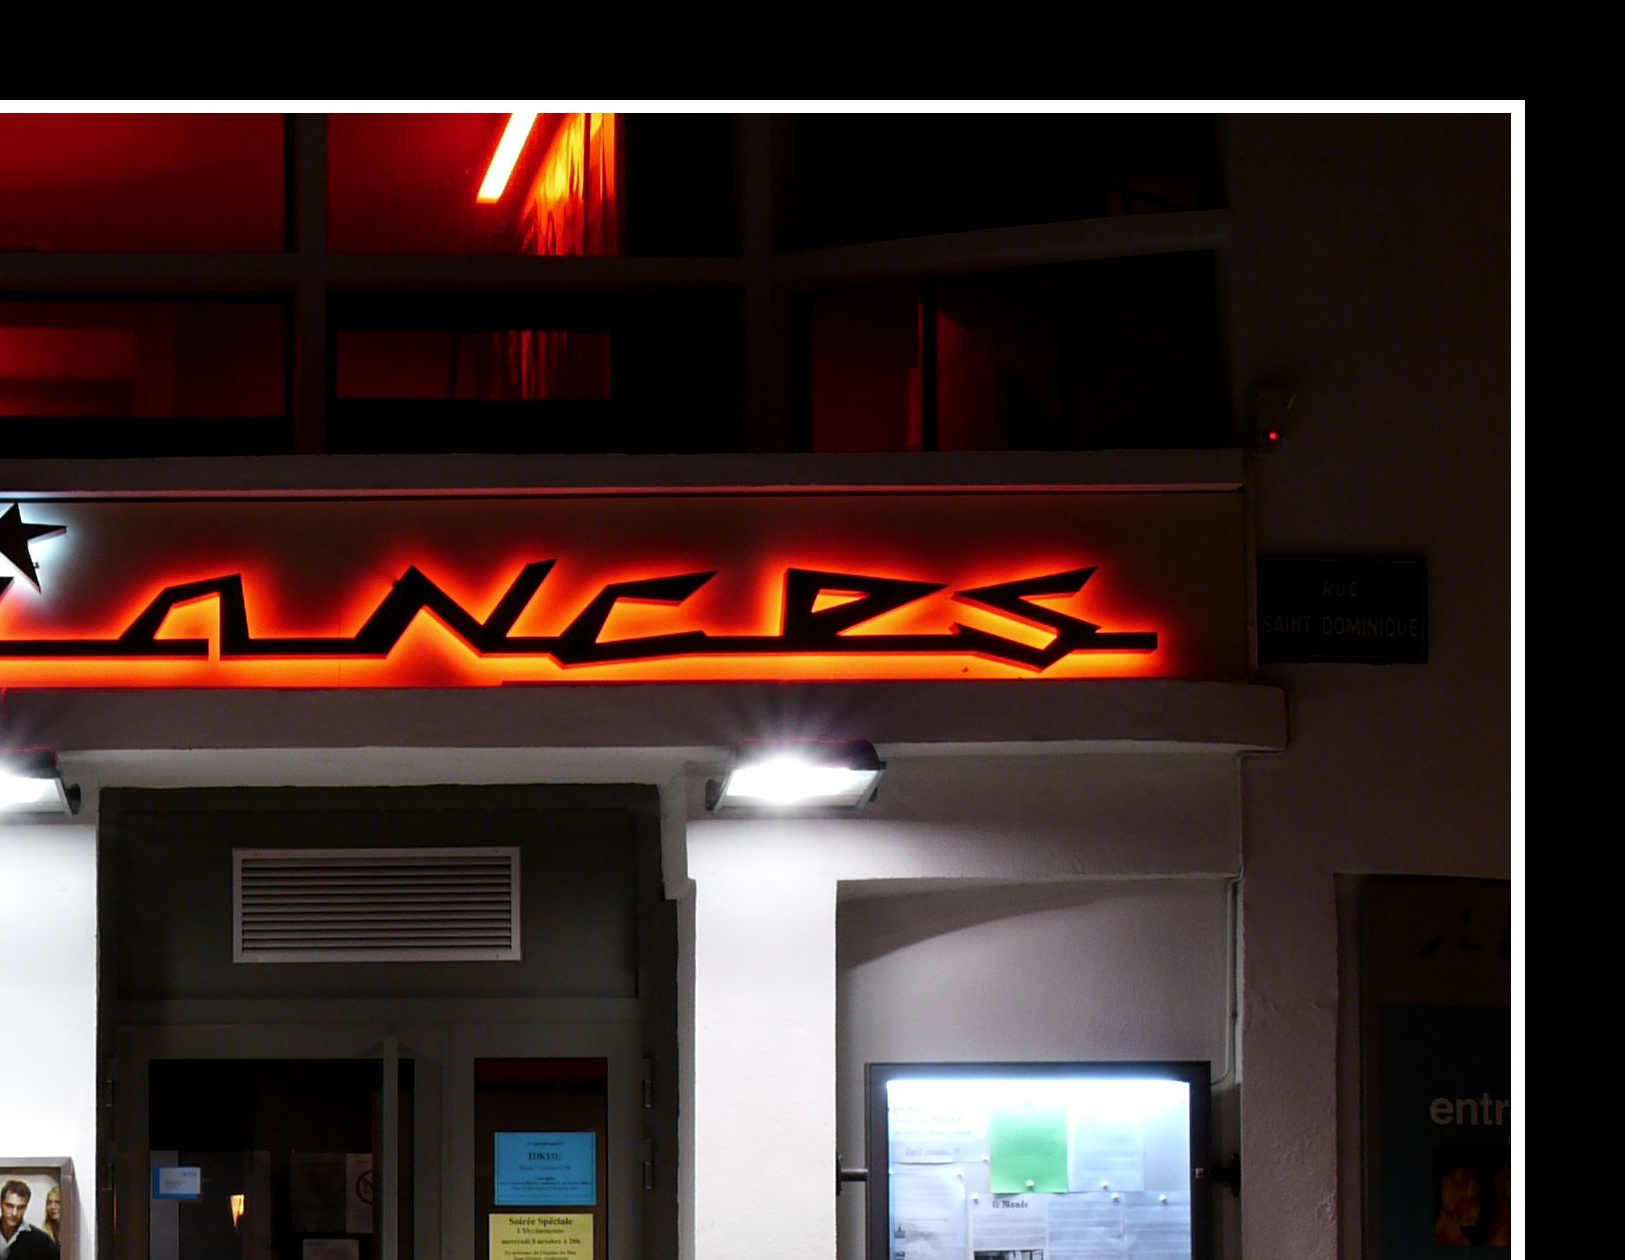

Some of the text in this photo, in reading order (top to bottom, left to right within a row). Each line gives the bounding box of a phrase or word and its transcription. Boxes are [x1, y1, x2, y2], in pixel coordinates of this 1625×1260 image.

[1323, 580, 1359, 597] RUE
[1262, 615, 1420, 638] SAINT DOMINIQUE
[509, 1217, 573, 1227] Soirée Spéciale
